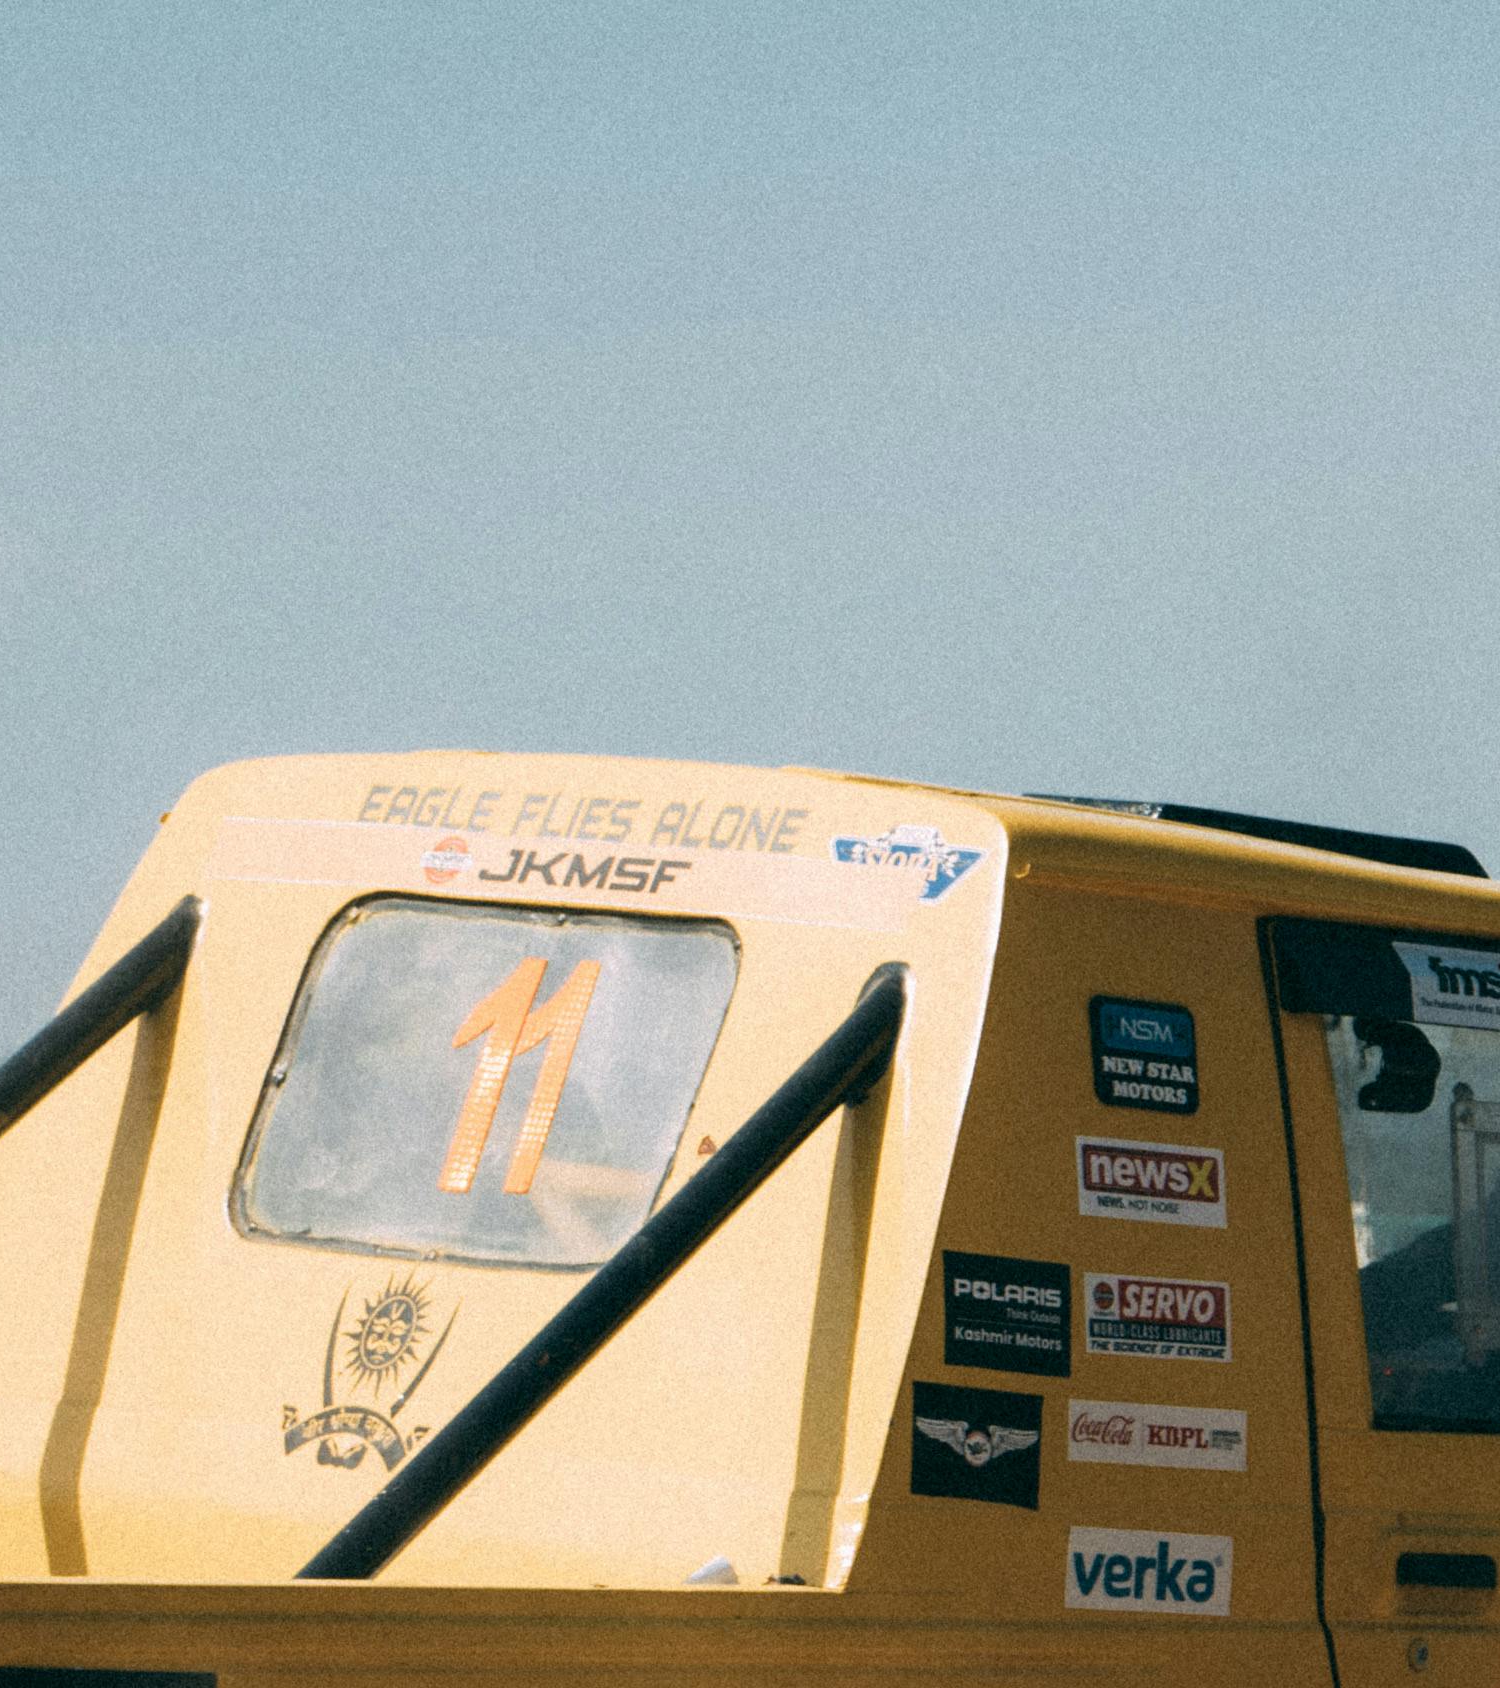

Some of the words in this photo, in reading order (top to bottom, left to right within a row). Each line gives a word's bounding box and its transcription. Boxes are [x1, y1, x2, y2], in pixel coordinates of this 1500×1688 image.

[357, 785, 500, 834] EAGLE
[509, 791, 643, 843] FLIES
[650, 799, 809, 853] ALONE
[478, 848, 692, 894] JKMSF
[1120, 1017, 1173, 1043] NSM
[438, 956, 603, 1194] 11
[1102, 1055, 1143, 1077] NEW
[1147, 1061, 1195, 1084] STAR
[1113, 1079, 1188, 1105] MOTORS
[954, 1278, 1062, 1308] POLARIS
[1122, 1284, 1216, 1323] SERVO
[955, 1326, 1013, 1345] Kashmir
[1015, 1332, 1062, 1351] Motors
[1147, 1425, 1209, 1449] KBPL
[1072, 1540, 1216, 1603] verka
